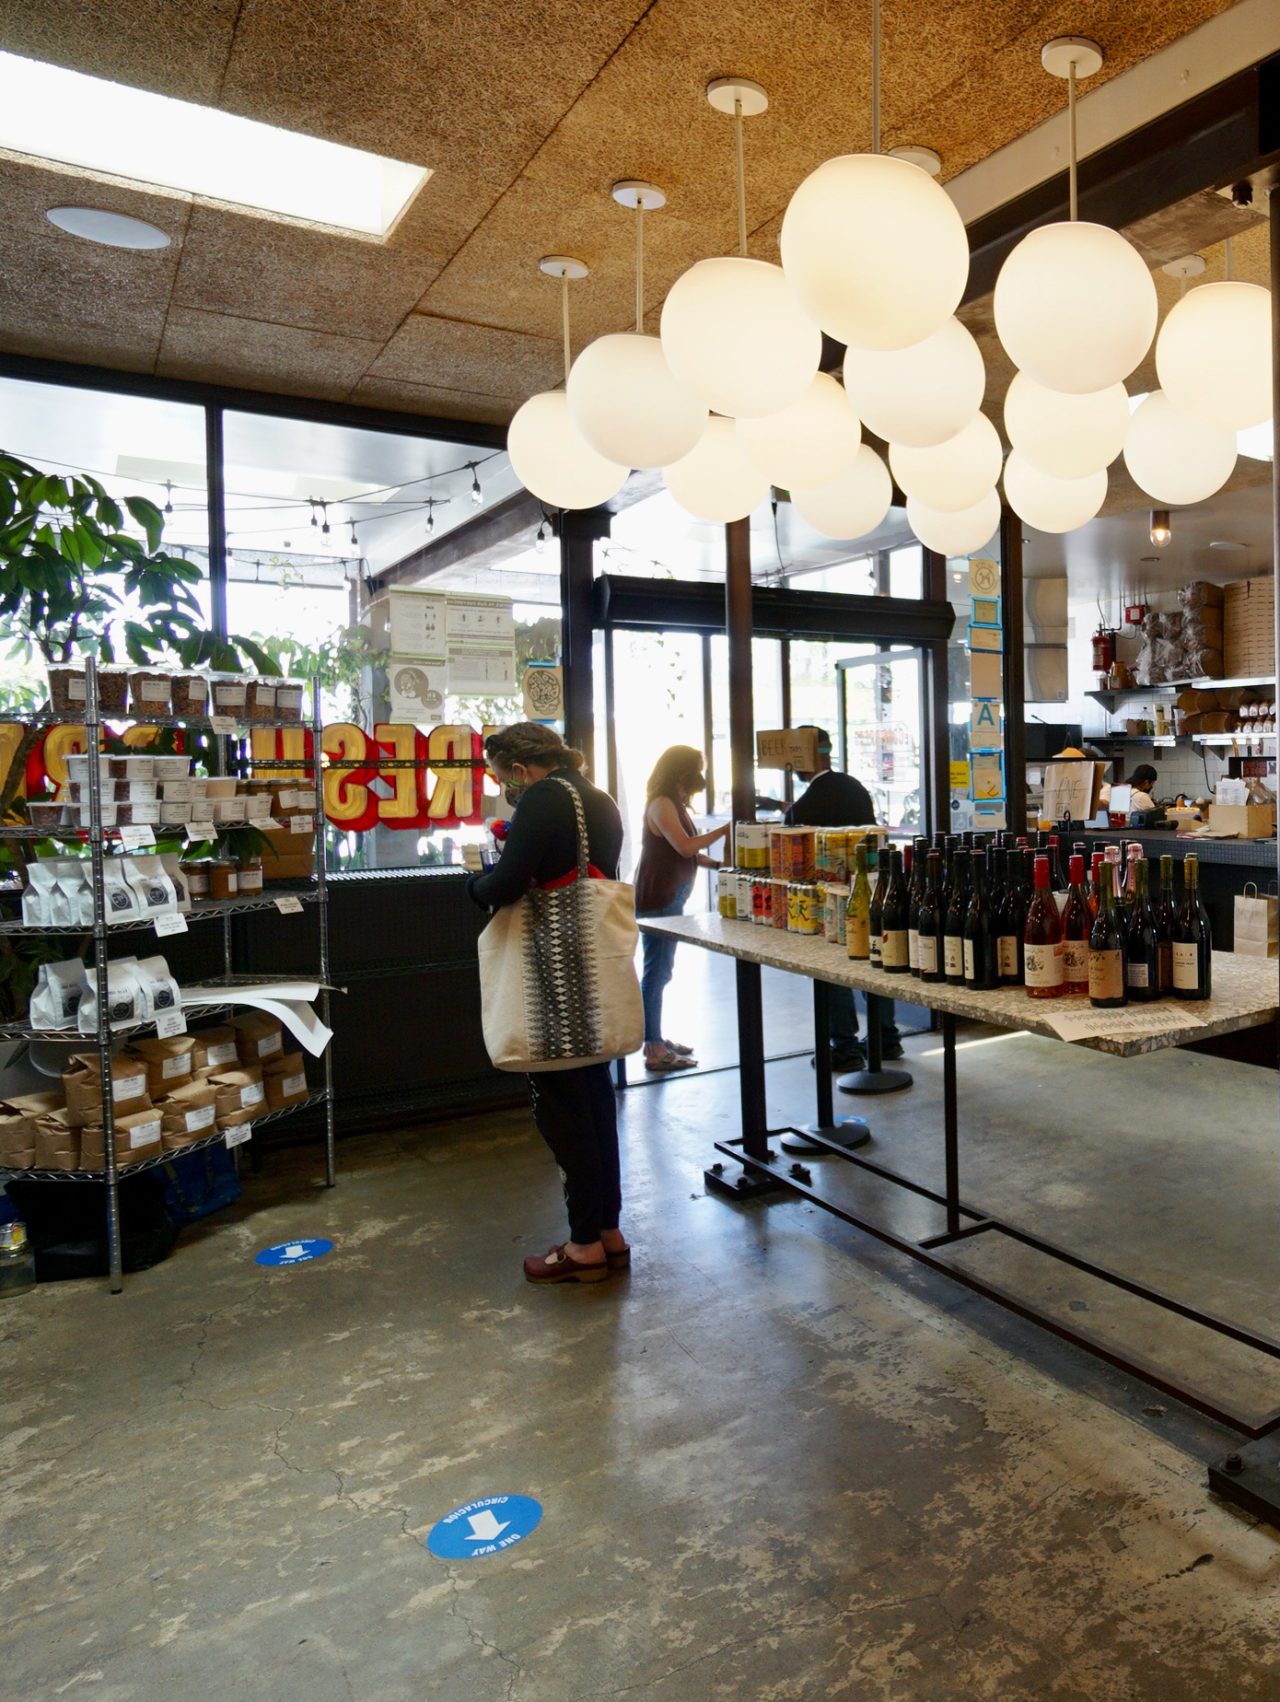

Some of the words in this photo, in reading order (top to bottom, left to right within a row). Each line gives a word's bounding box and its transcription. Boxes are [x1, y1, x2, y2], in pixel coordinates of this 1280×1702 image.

[977, 703, 995, 725] A
[498, 1533, 521, 1548] ONE
[471, 1544, 497, 1557] WAY
